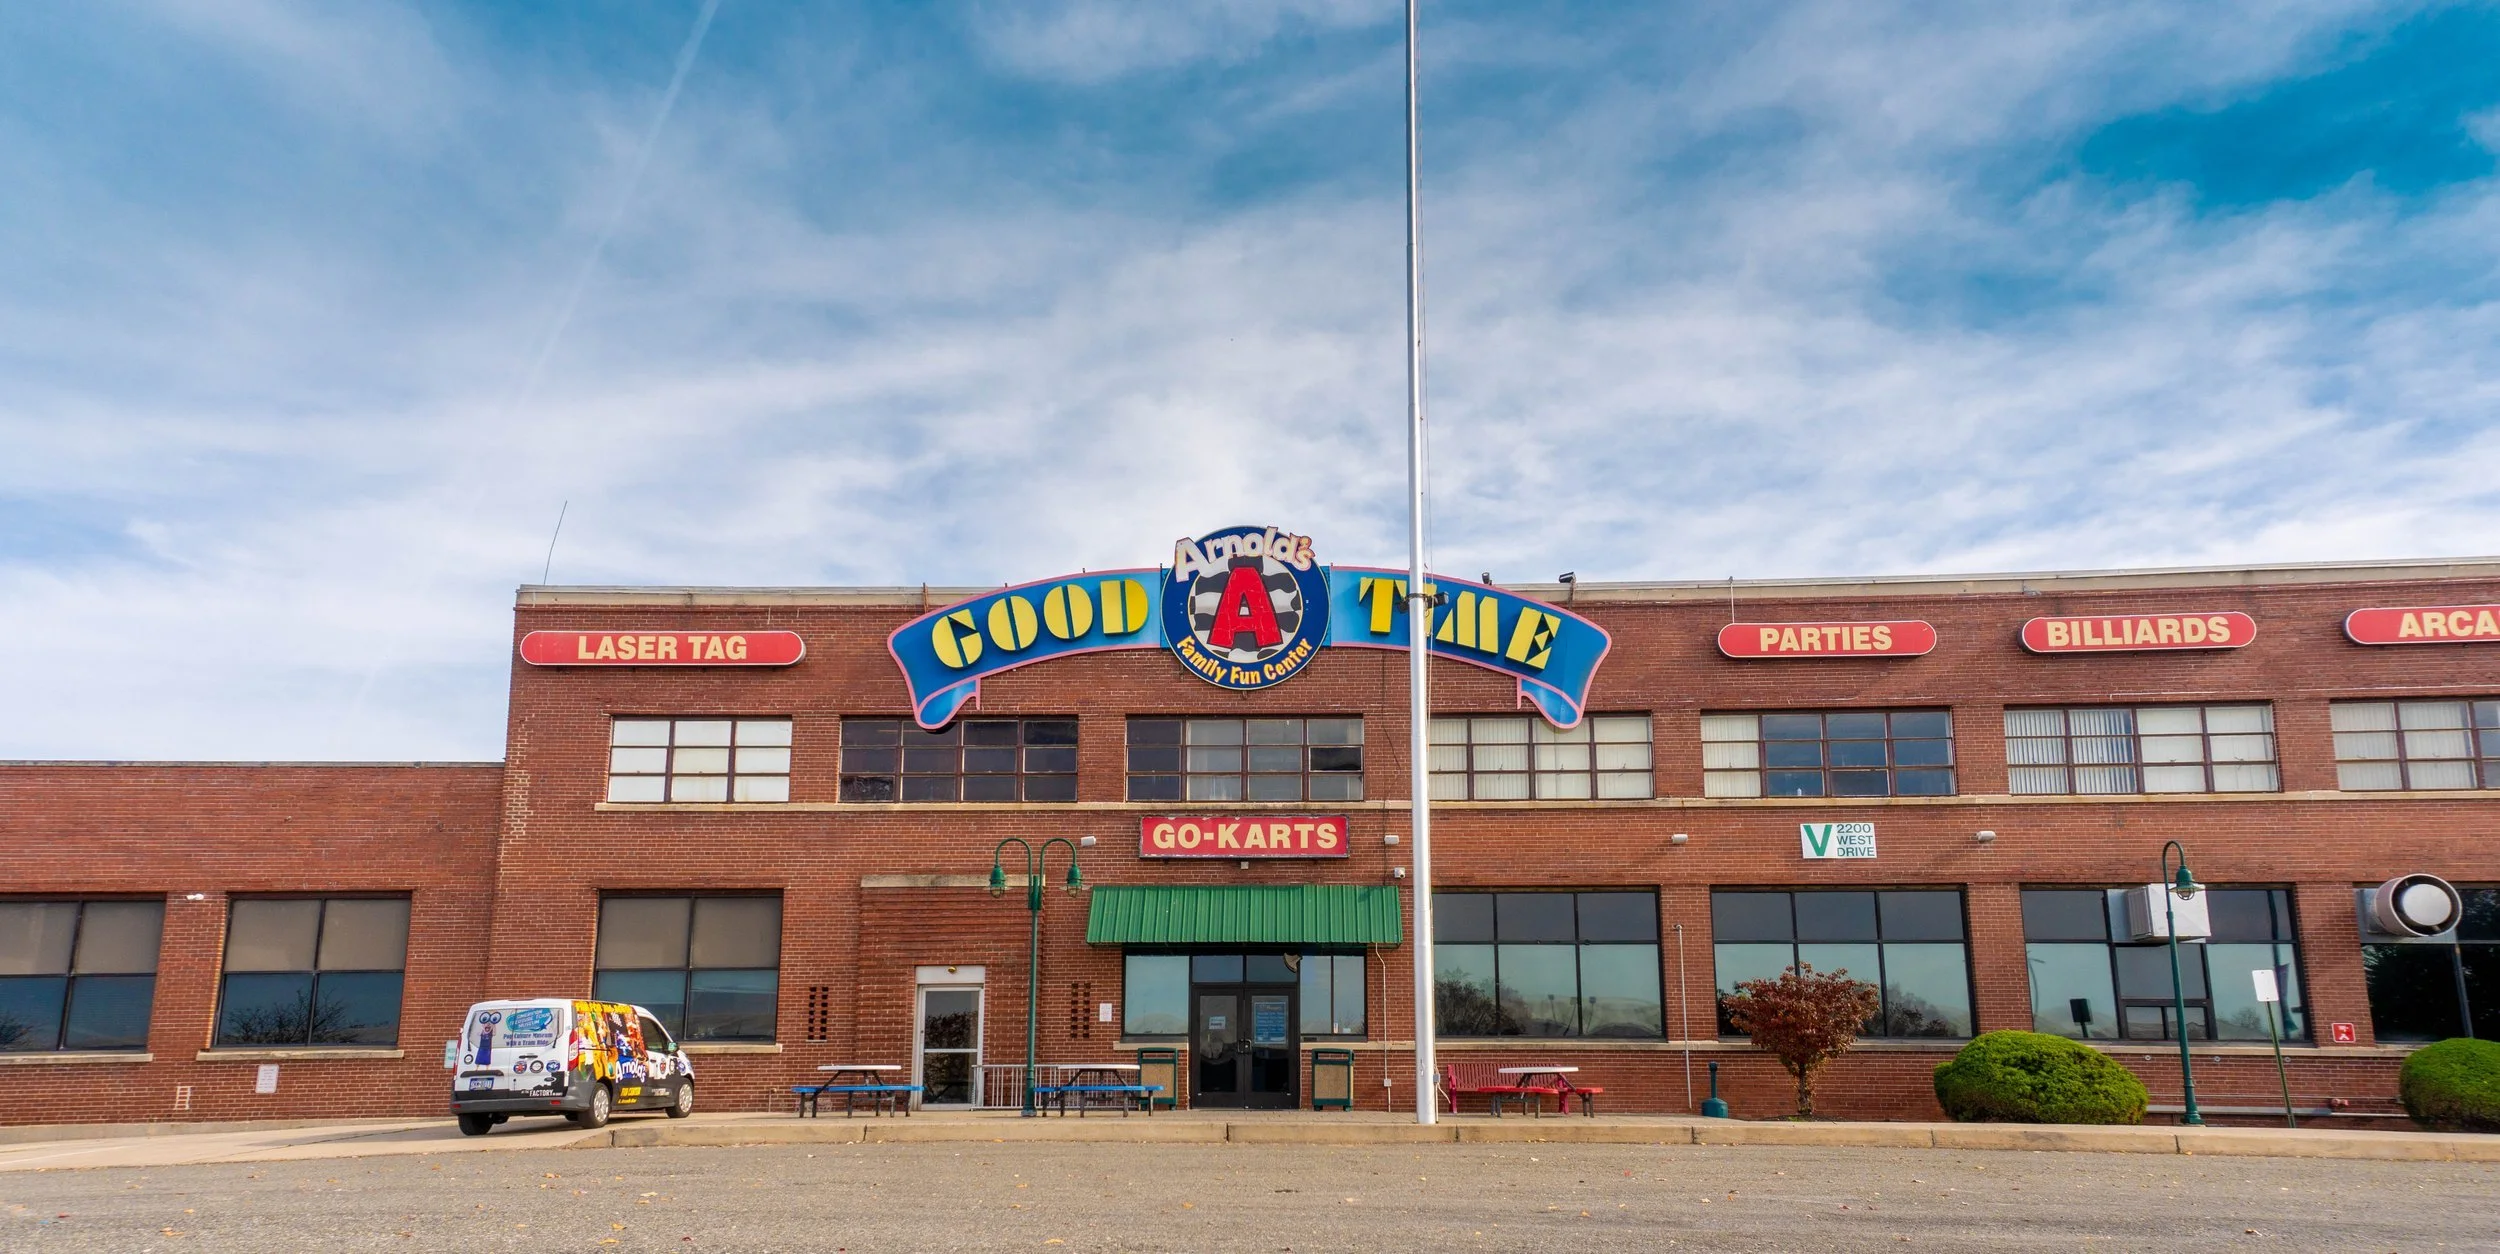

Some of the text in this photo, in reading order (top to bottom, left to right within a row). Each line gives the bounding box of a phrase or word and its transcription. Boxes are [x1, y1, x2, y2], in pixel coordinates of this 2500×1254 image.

[1175, 526, 1315, 582] Arnold's
[1207, 566, 1283, 649] A
[932, 579, 1149, 669] GOOD
[2047, 616, 2231, 647] BILLIARDS
[2398, 610, 2500, 638] ARCA
[578, 635, 747, 659] LASER TAG
[1760, 625, 1893, 651] PARTIES
[1177, 636, 1313, 684] Family Fun Center
[1153, 823, 1338, 849] GO-KARTS
[1803, 825, 1832, 857] V
[1836, 823, 1871, 834] 2200
[1836, 835, 1873, 845] WEST
[1837, 847, 1875, 857] DRIVE
[529, 1089, 554, 1097] FACTORY
